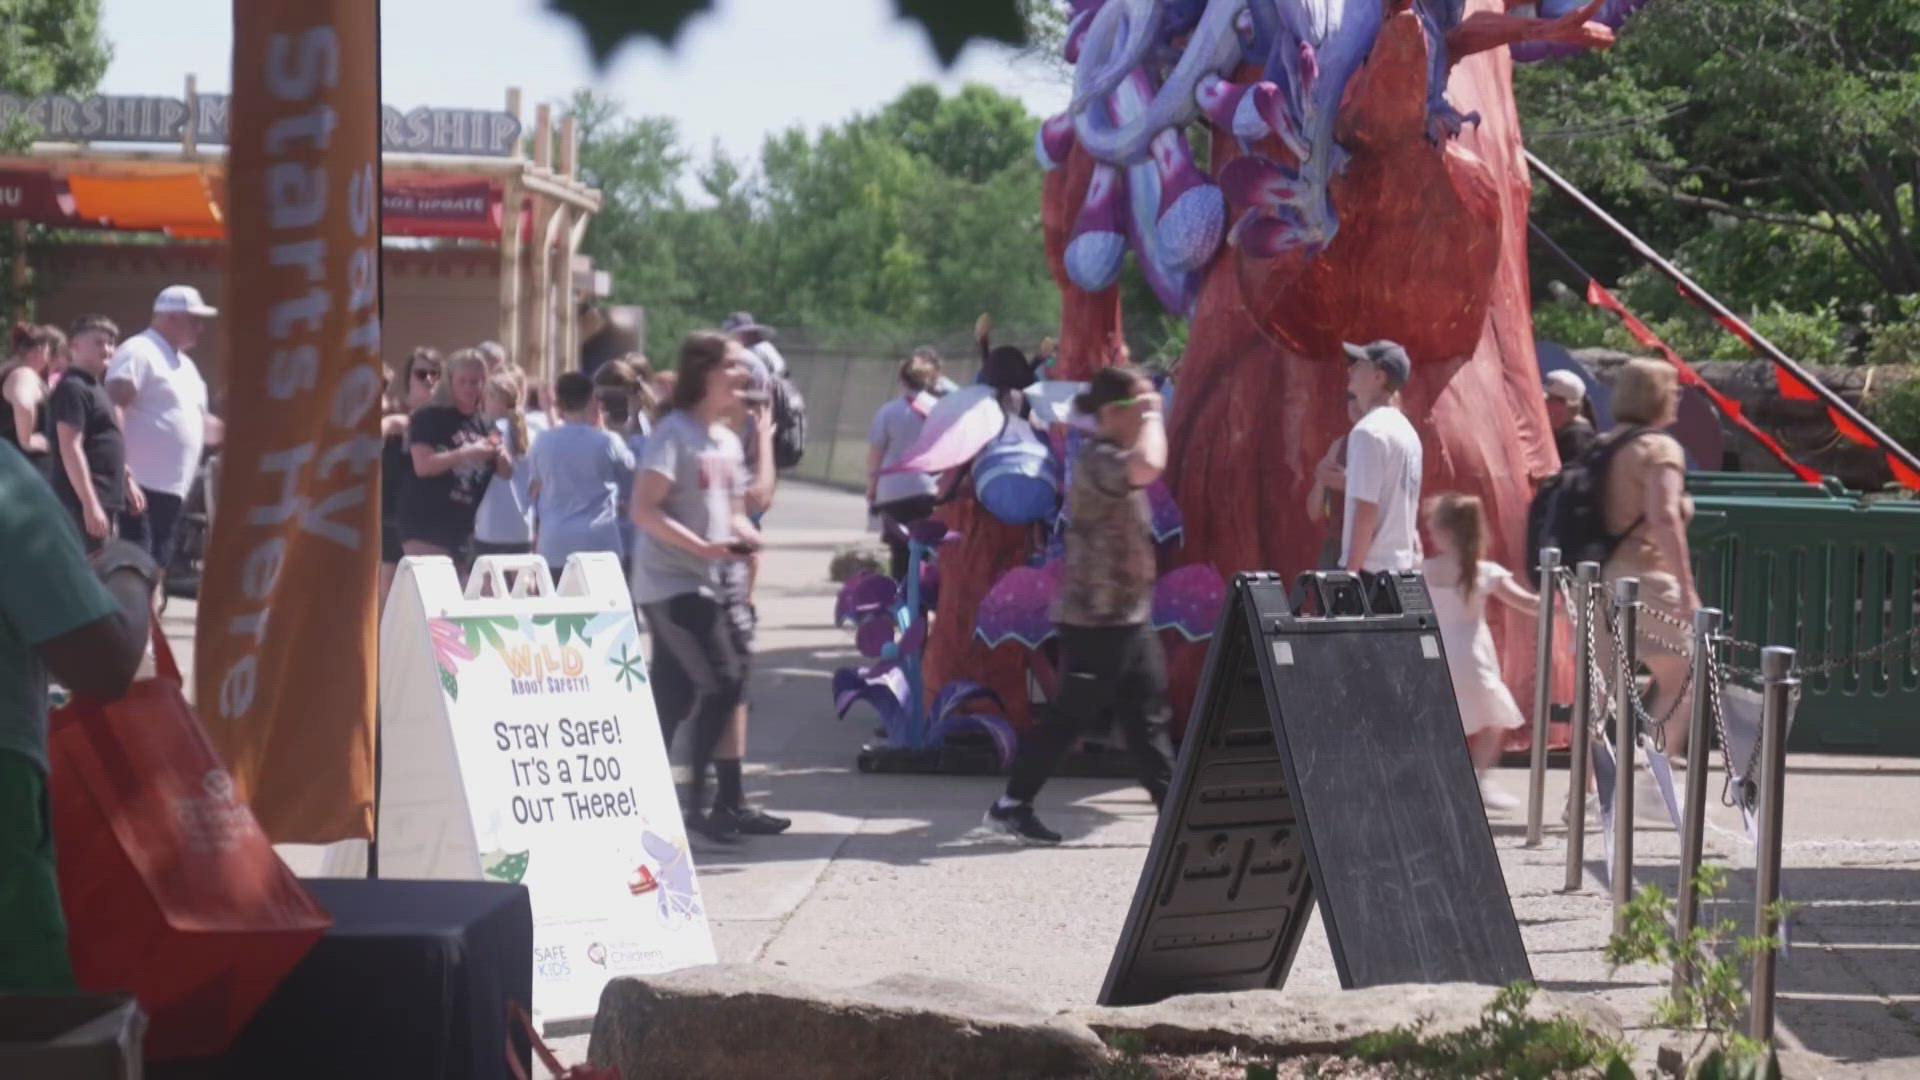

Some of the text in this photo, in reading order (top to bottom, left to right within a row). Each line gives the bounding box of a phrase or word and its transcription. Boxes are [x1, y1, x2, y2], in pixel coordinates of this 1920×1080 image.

[217, 28, 340, 721] Starts Here
[557, 760, 572, 783] a
